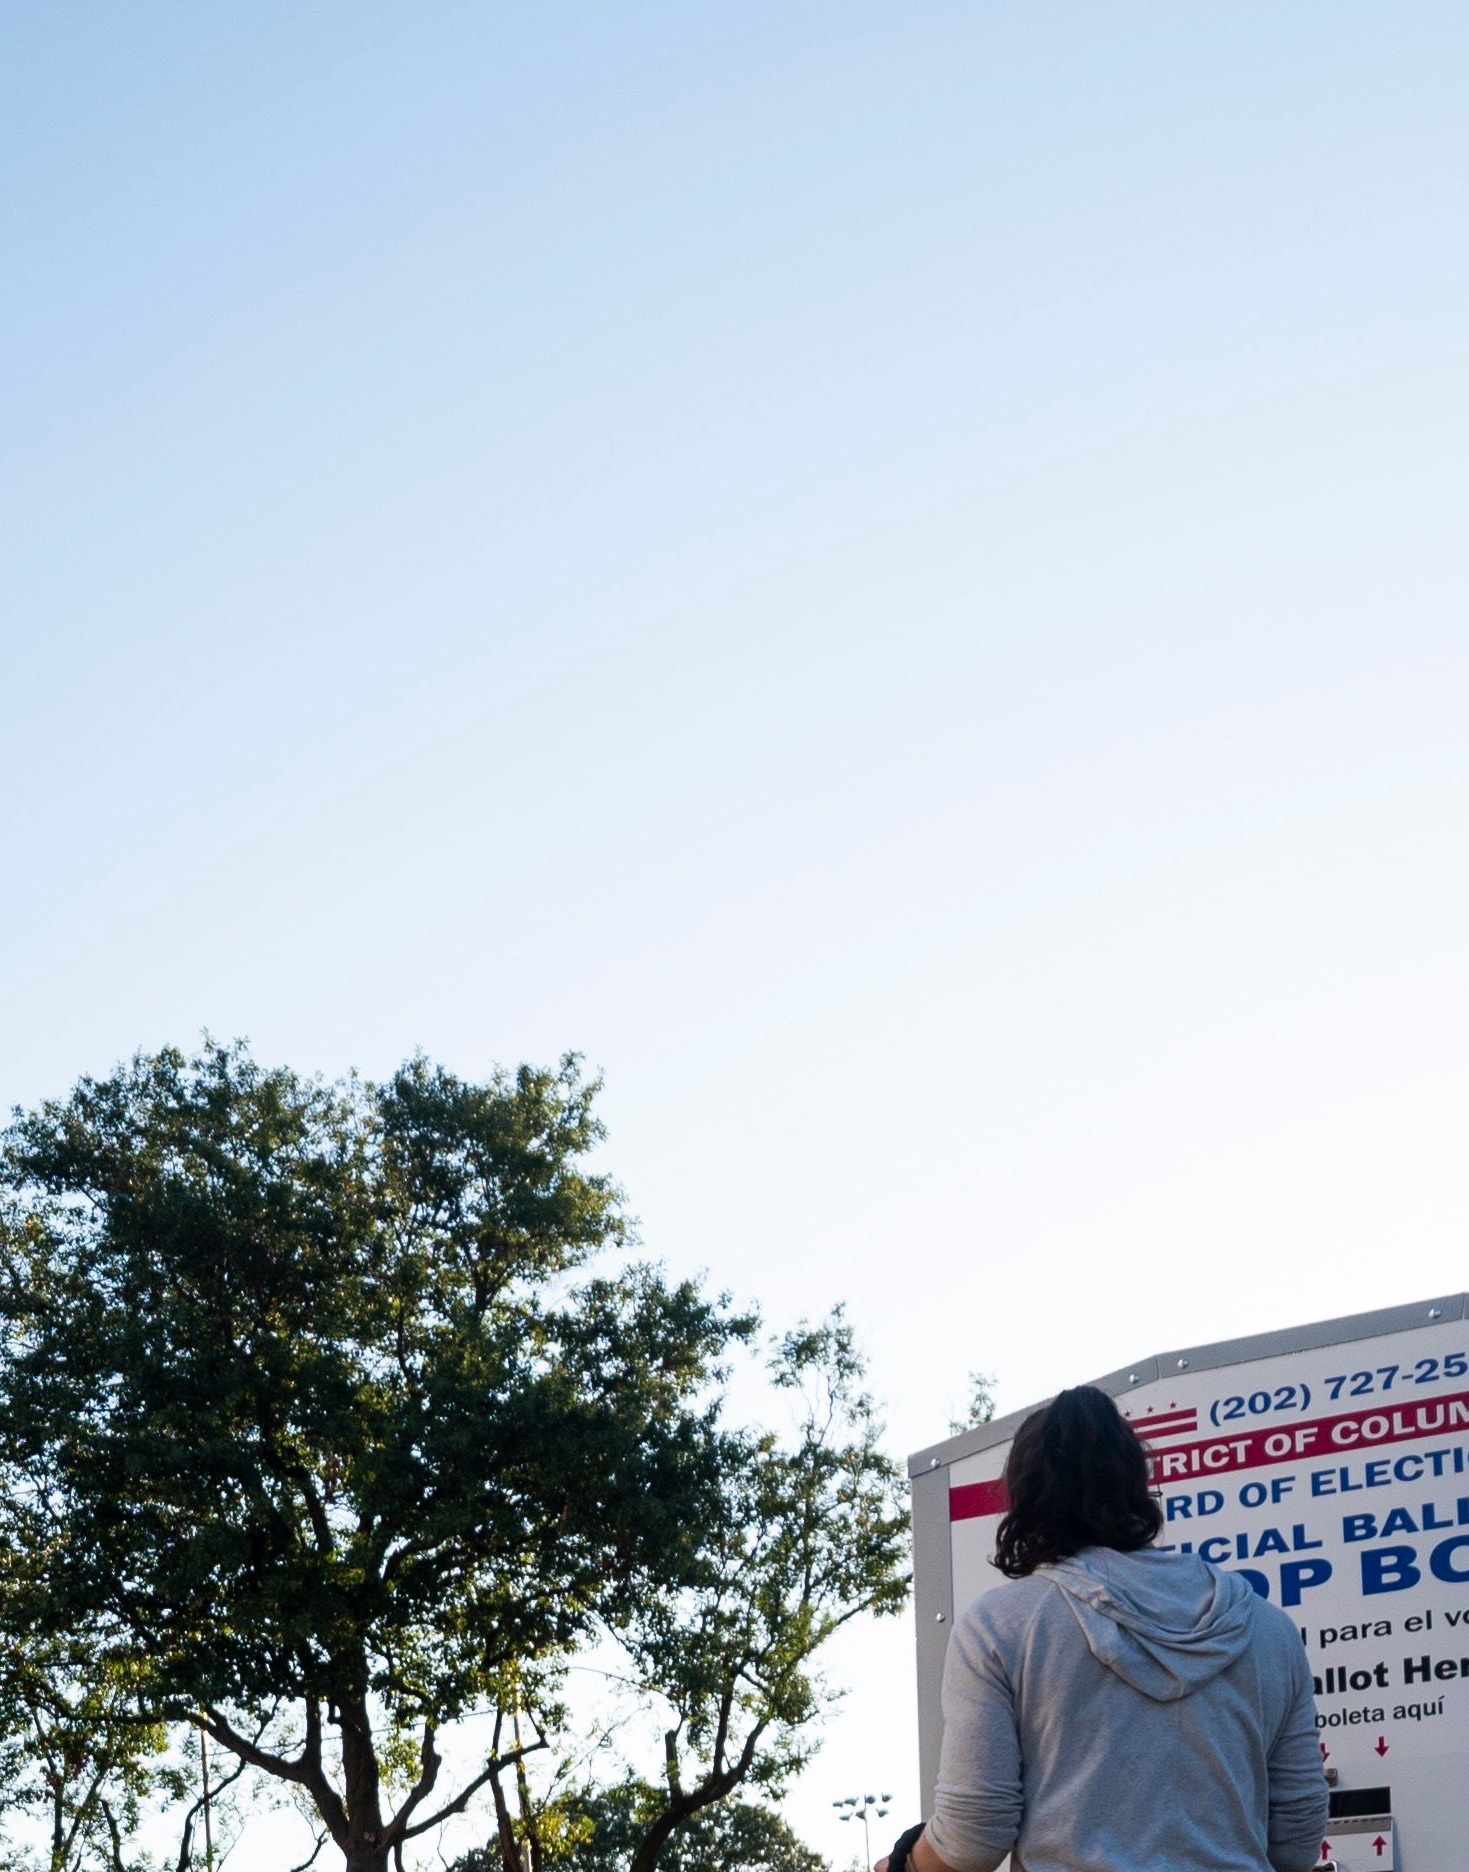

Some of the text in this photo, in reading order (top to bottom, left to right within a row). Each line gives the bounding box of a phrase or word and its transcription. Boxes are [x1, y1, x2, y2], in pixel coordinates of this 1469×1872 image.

[1209, 1383, 1312, 1427] (202)
[1146, 1438, 1254, 1480] TRICT
[1264, 1427, 1319, 1458] OF
[1238, 1476, 1296, 1508] OF
[1320, 1620, 1393, 1649] para
[1404, 1610, 1433, 1633] el
[1314, 1661, 1390, 1696] allot
[1393, 1695, 1446, 1722] aquí
